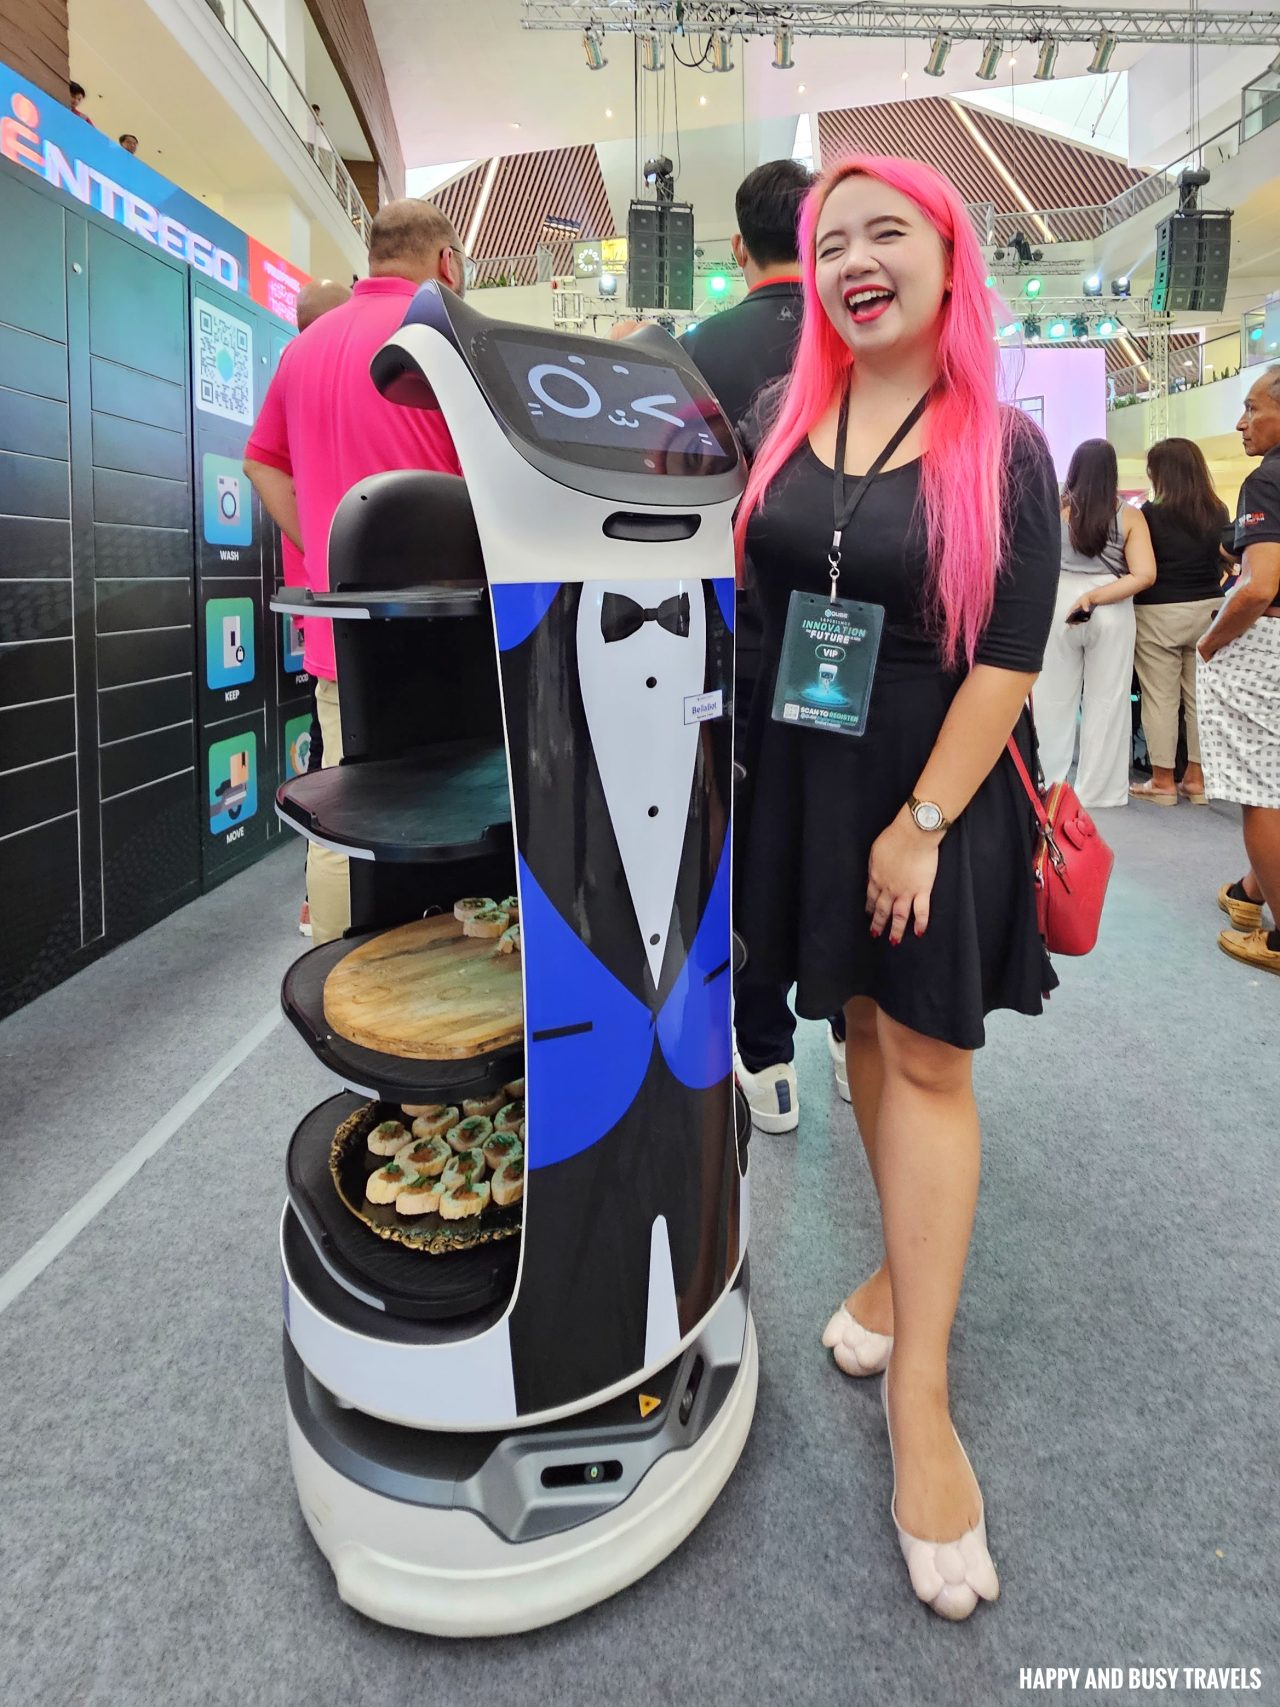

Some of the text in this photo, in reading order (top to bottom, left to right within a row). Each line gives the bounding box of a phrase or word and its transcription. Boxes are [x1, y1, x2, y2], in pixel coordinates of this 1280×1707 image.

[1, 114, 240, 292] ENTREGO
[220, 550, 239, 561] WASH
[802, 620, 866, 637] INNOVATION
[810, 630, 850, 644] FUTURE
[823, 648, 839, 658] VIP
[295, 674, 309, 684] FOOD
[225, 690, 240, 701] KEEP
[801, 706, 819, 716] SCAN
[226, 826, 245, 844] MOVE
